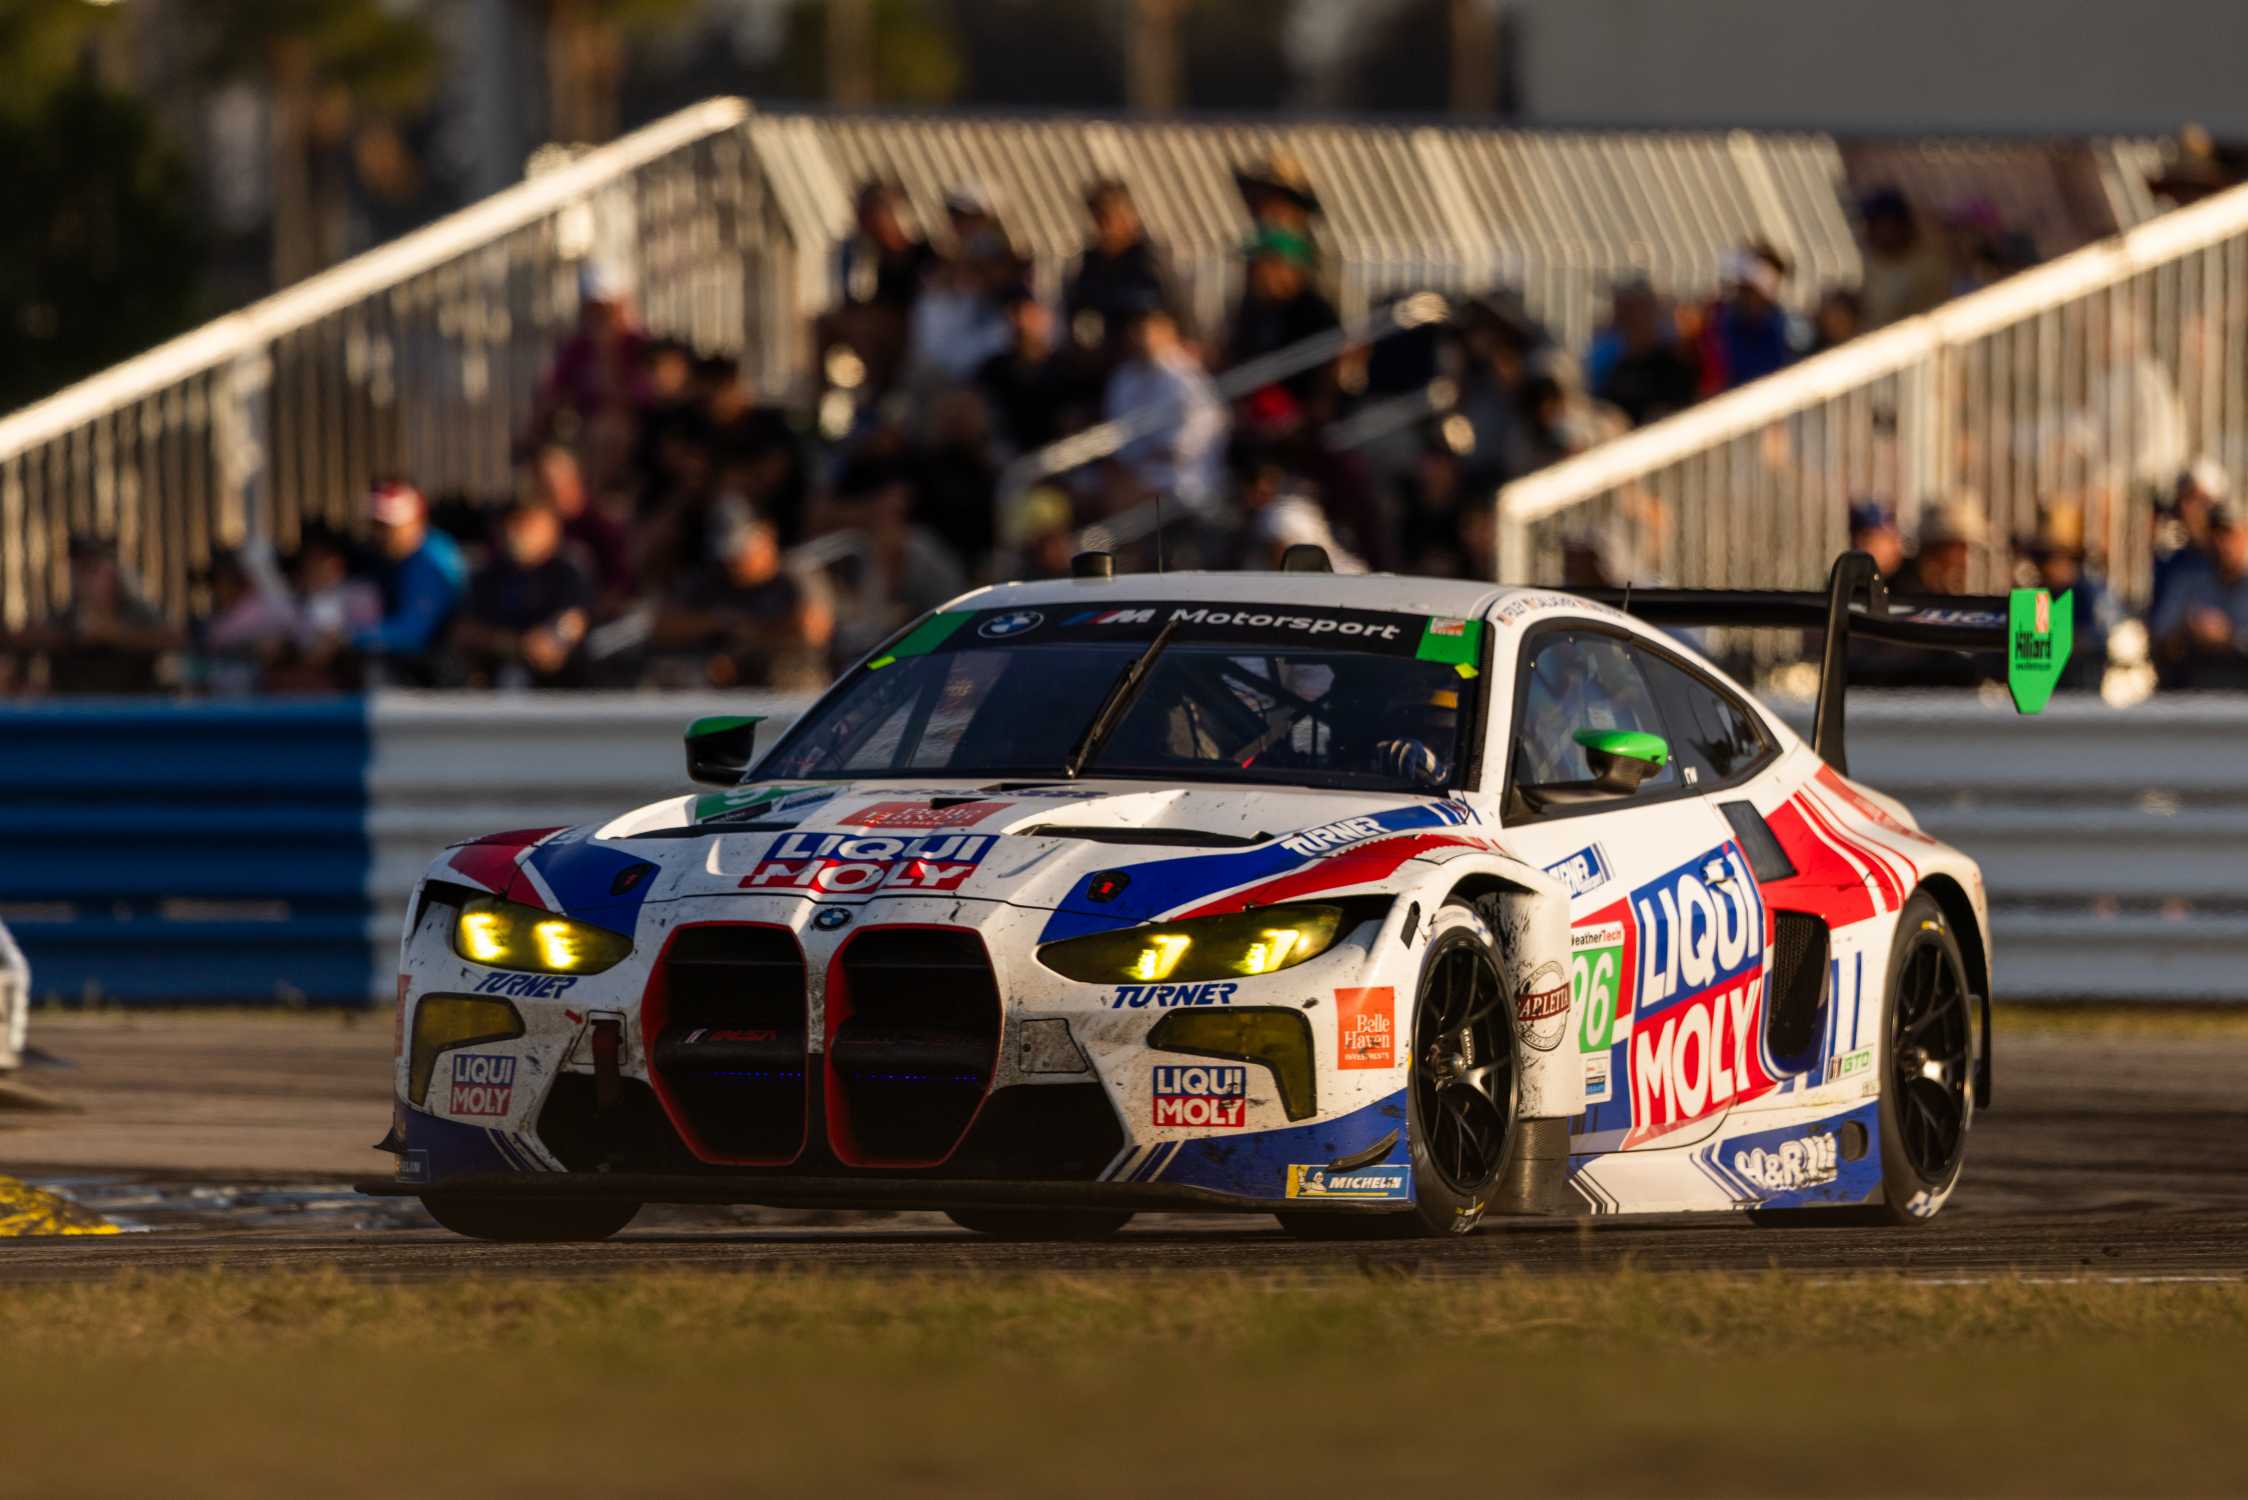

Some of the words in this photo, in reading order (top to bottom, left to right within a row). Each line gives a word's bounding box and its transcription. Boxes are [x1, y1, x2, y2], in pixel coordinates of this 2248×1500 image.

[1170, 608, 1402, 640] Motorsport
[776, 834, 990, 863] LIQUI
[1280, 816, 1391, 857] TURNER
[750, 859, 970, 891] MOLY
[1638, 850, 1760, 1009] LIQUI
[473, 972, 579, 1000] TURNER
[1111, 982, 1238, 1009] TURNER
[1355, 1013, 1391, 1033] Belle
[1343, 1030, 1391, 1049] Haven
[453, 1056, 513, 1085] LIQUI
[1634, 976, 1762, 1138] MOLY
[1156, 1067, 1243, 1095] LIQUI
[452, 1086, 512, 1115] MOLY
[1156, 1097, 1245, 1126] MOLY
[1328, 1176, 1403, 1190] MICHELIN
